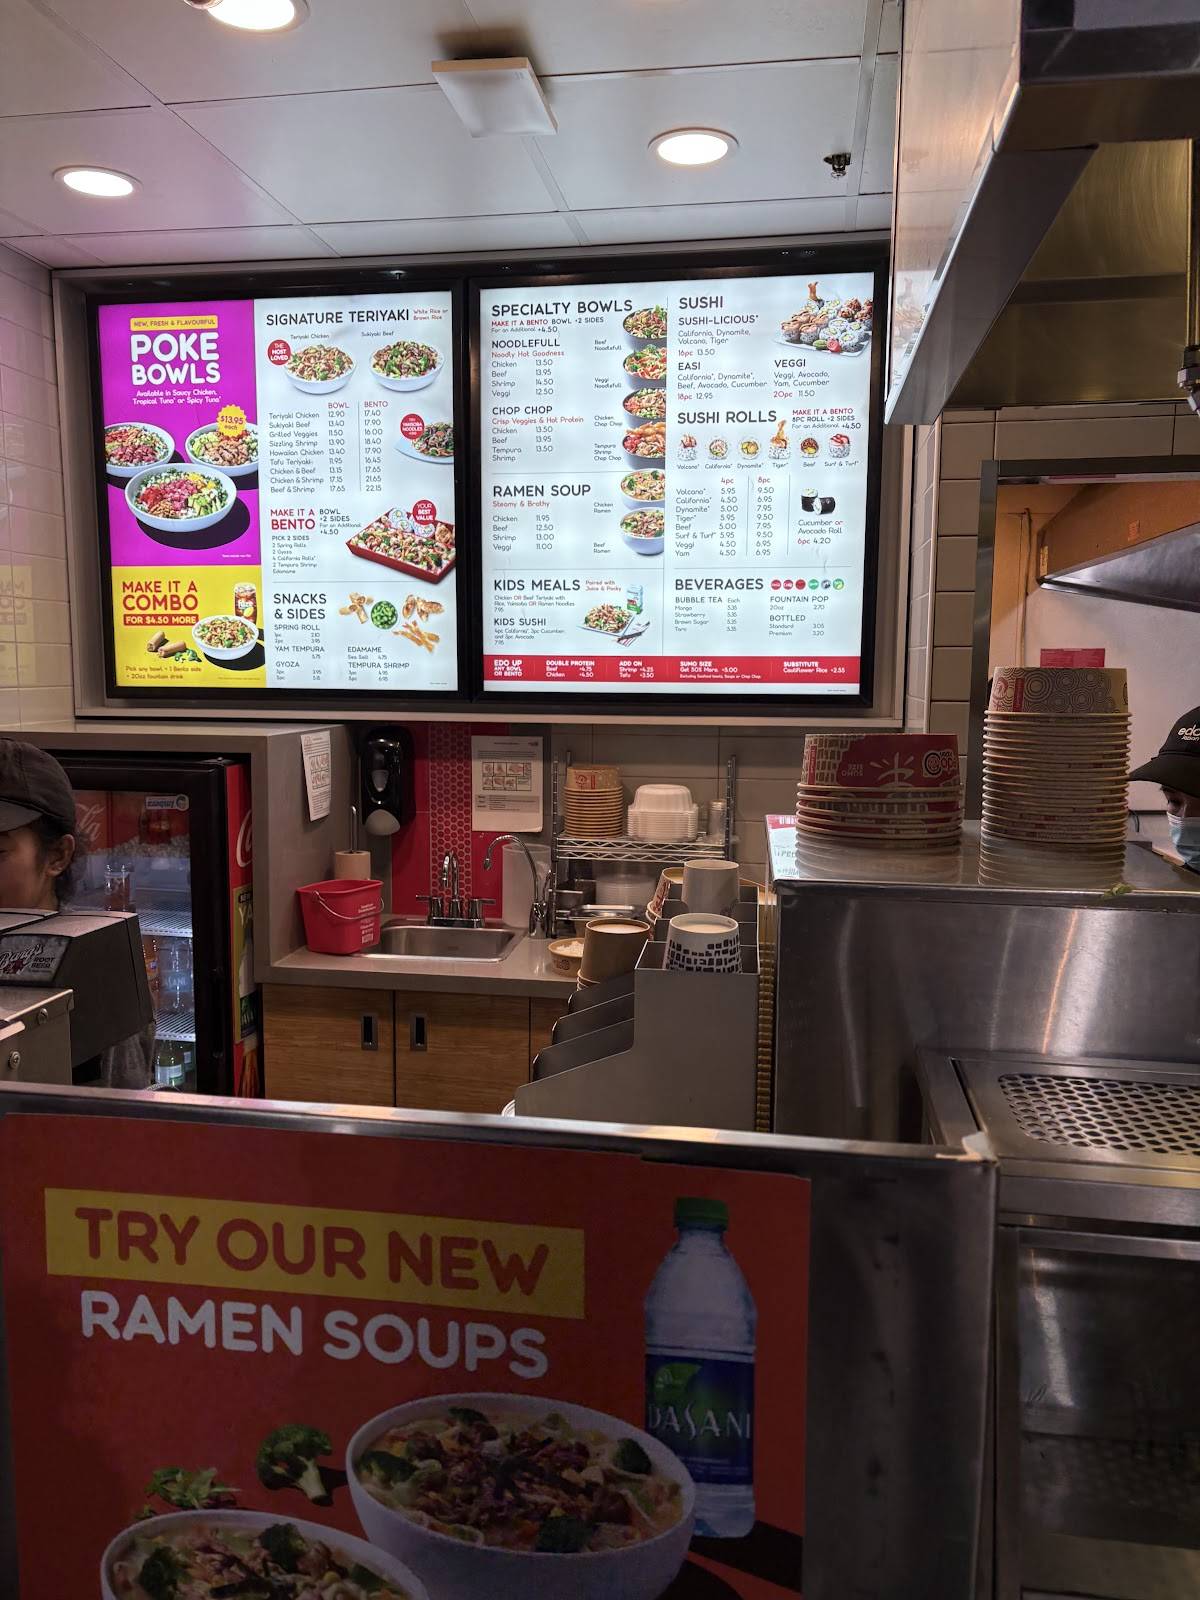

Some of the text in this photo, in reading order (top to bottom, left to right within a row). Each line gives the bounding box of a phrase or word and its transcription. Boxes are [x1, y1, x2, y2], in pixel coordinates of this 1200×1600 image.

[679, 296, 723, 309] SUSHI
[492, 300, 632, 317] SPECIALTY BOWLS
[266, 309, 409, 326] SIGNATURE TERIYAKI
[131, 333, 219, 362] POKE
[492, 339, 560, 348] NOODLEFULL
[775, 359, 806, 367] VEGGI
[132, 362, 221, 385] BOWLS
[678, 382, 696, 390] Beef,
[492, 406, 552, 415] CHOP CHOP
[221, 415, 243, 424] $13.95
[678, 411, 777, 423] SUSHI ROLLS
[493, 485, 591, 497] RAMEN SOUP
[528, 500, 549, 508] Brothy
[272, 519, 315, 530] BENTO
[123, 581, 197, 592] MAKE IT A
[494, 580, 580, 590] KIDS MEALS
[675, 579, 763, 590] BEVERAGES
[123, 595, 198, 610] COMBO
[274, 594, 327, 604] SNACKS
[275, 609, 326, 619] & SIDES
[126, 616, 196, 624] FOR $4.50 MORE
[74, 1206, 550, 1296] TRY OUR NEW
[79, 1290, 550, 1379] RAMEN SOUPS
[648, 1401, 751, 1440] DASANI
